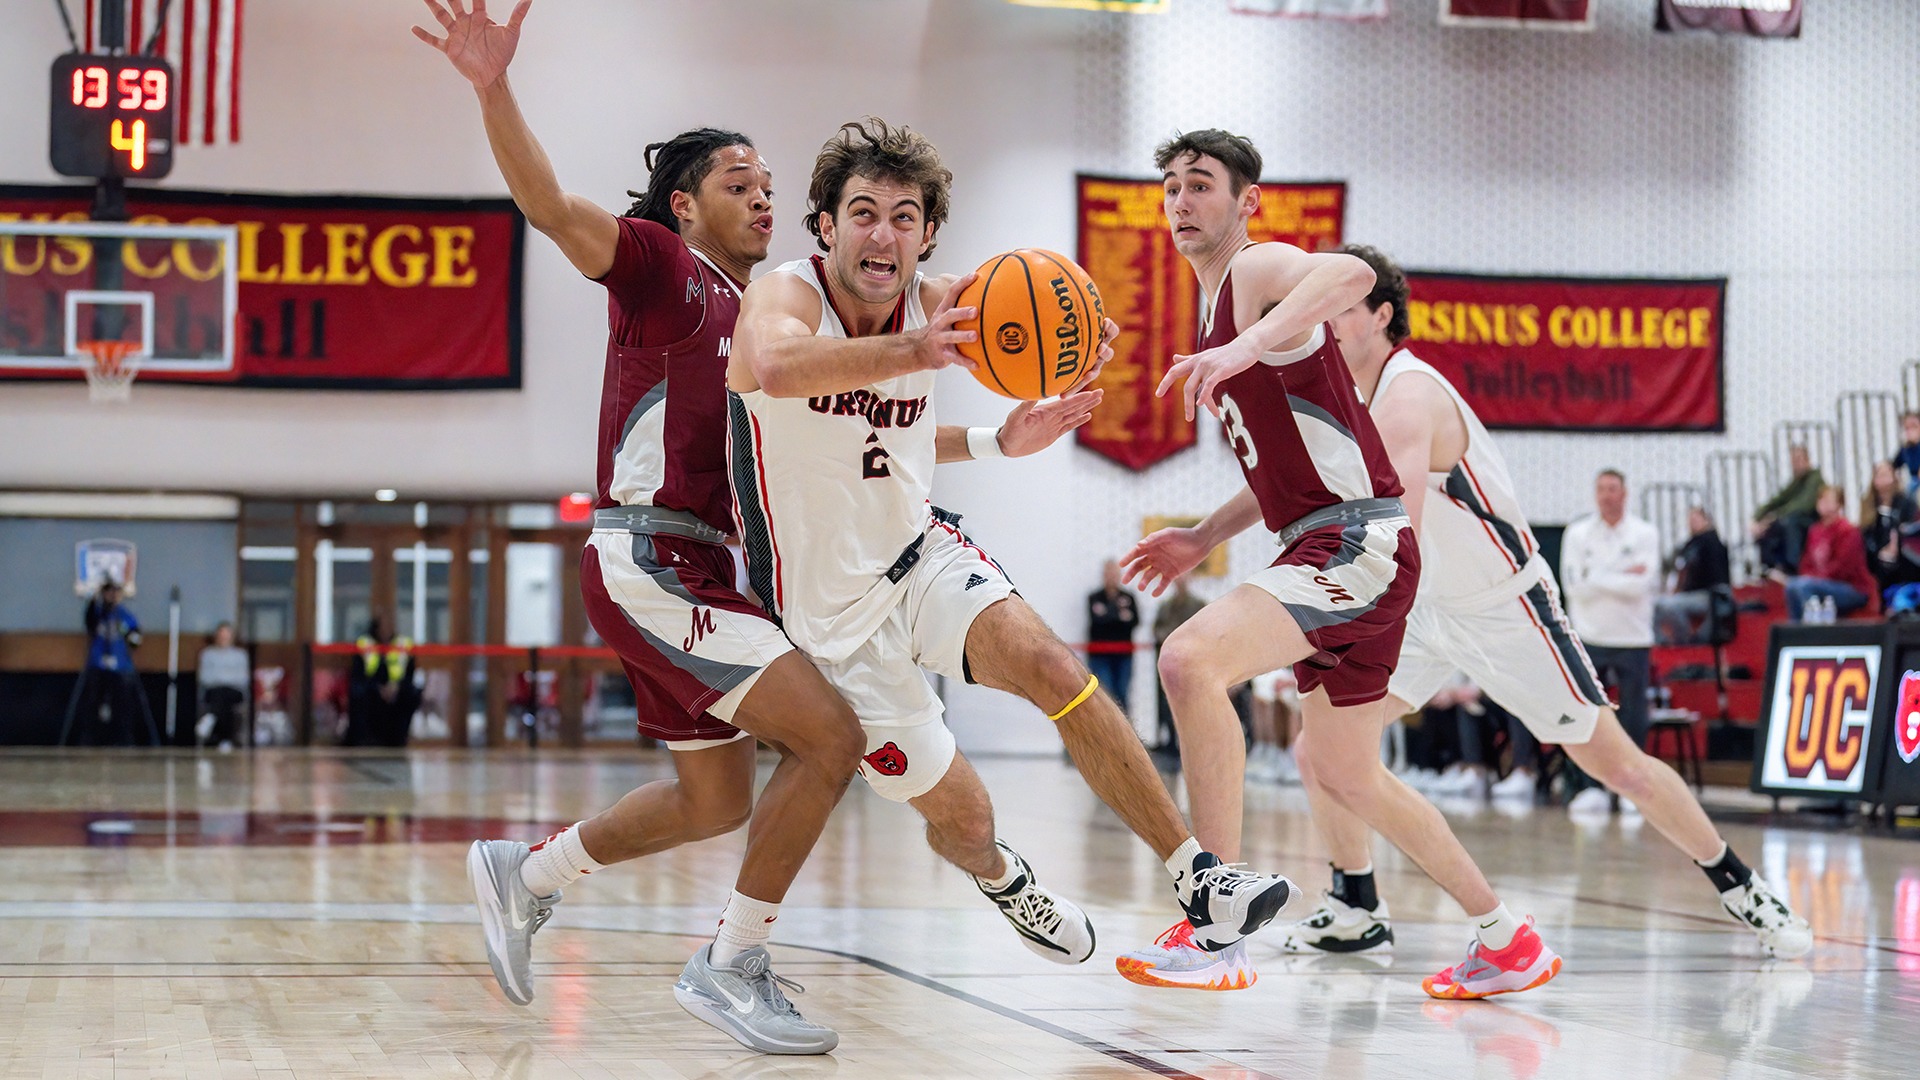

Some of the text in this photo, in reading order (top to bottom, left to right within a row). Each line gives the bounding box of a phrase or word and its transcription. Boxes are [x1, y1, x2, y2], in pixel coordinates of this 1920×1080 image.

[110, 118, 146, 171] 4
[121, 214, 478, 288] COLLEGE
[1050, 275, 1080, 380] Wilson
[1408, 300, 1712, 349] RSINUS COLLEGE
[964, 577, 989, 591] adidas
[683, 606, 717, 653] M
[1784, 657, 1871, 781] UC
